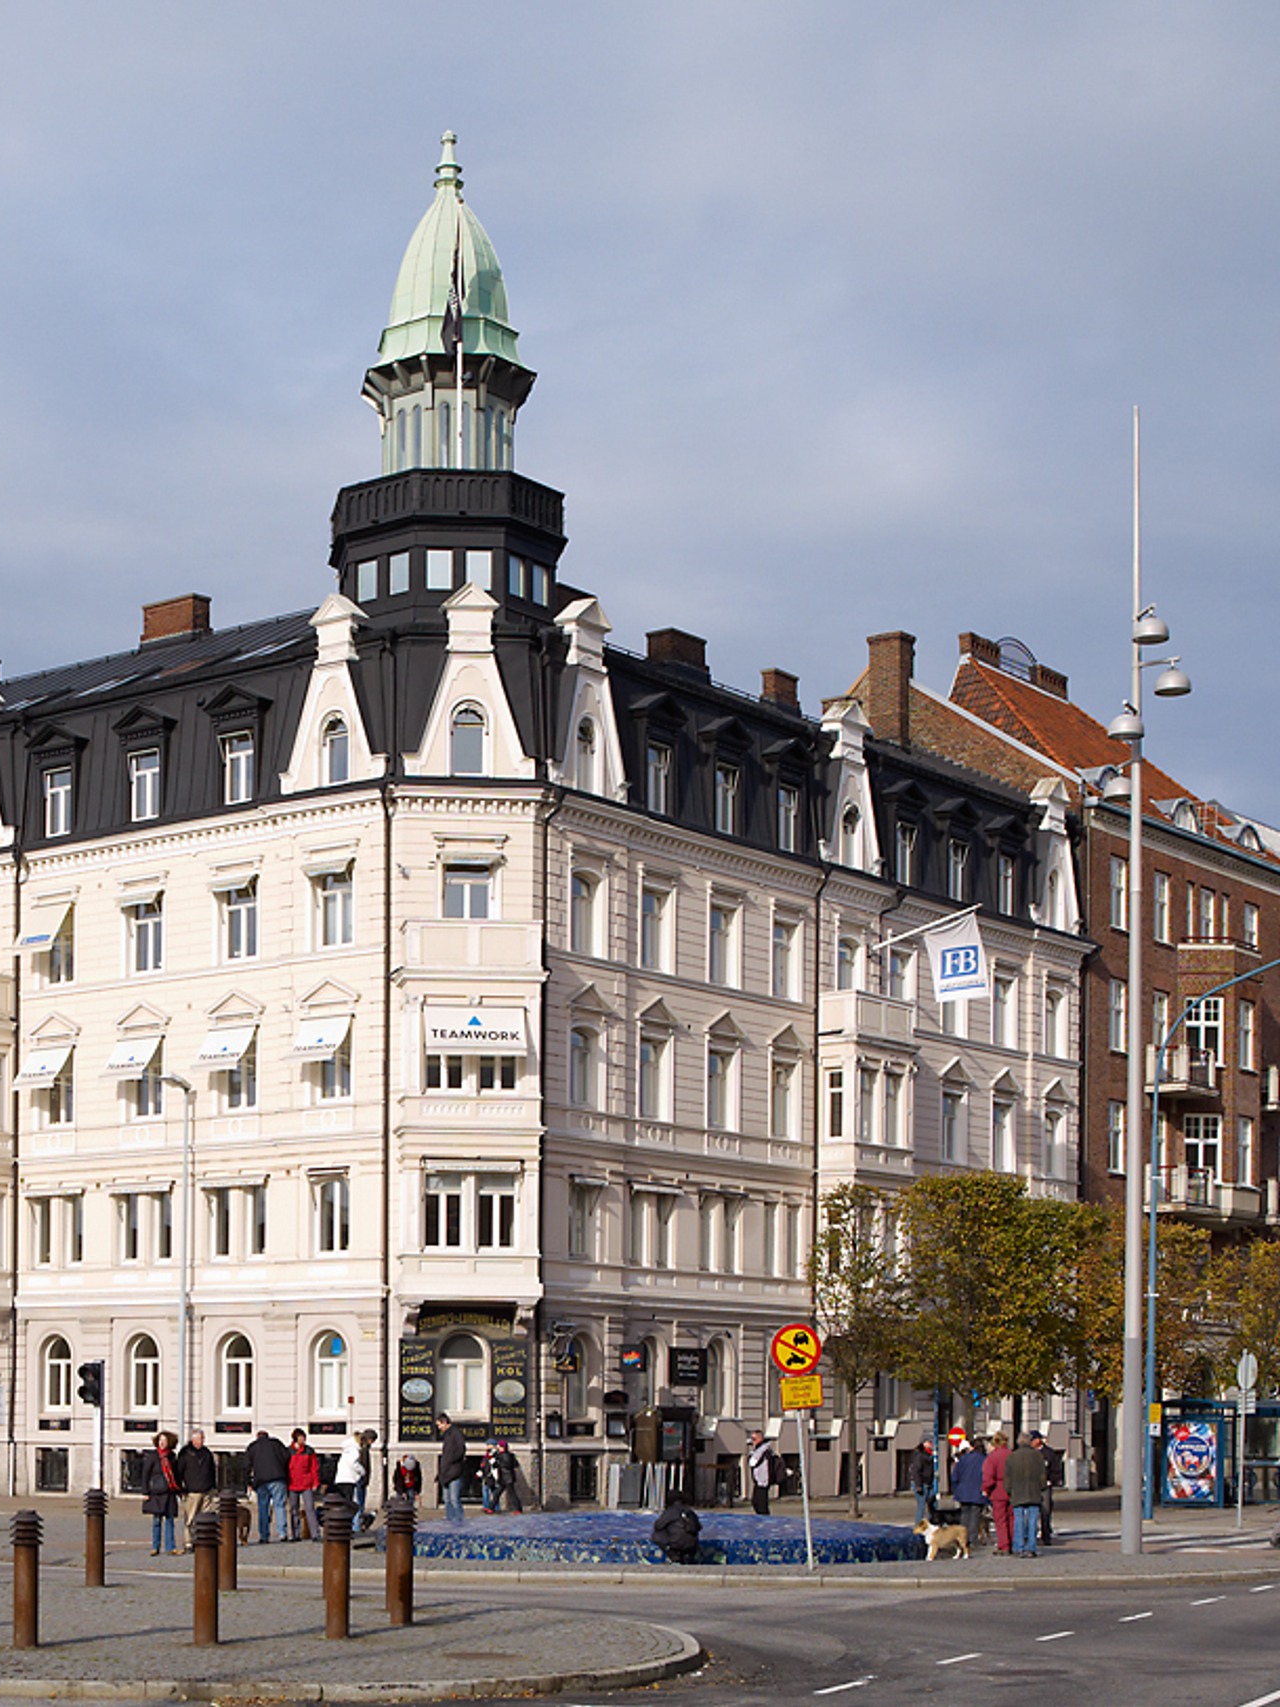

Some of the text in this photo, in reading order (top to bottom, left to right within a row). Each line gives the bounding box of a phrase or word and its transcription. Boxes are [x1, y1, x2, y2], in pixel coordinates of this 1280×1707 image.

[944, 949, 977, 976] FB
[431, 1028, 520, 1041] TEAMWORK
[496, 1366, 524, 1377] KOL
